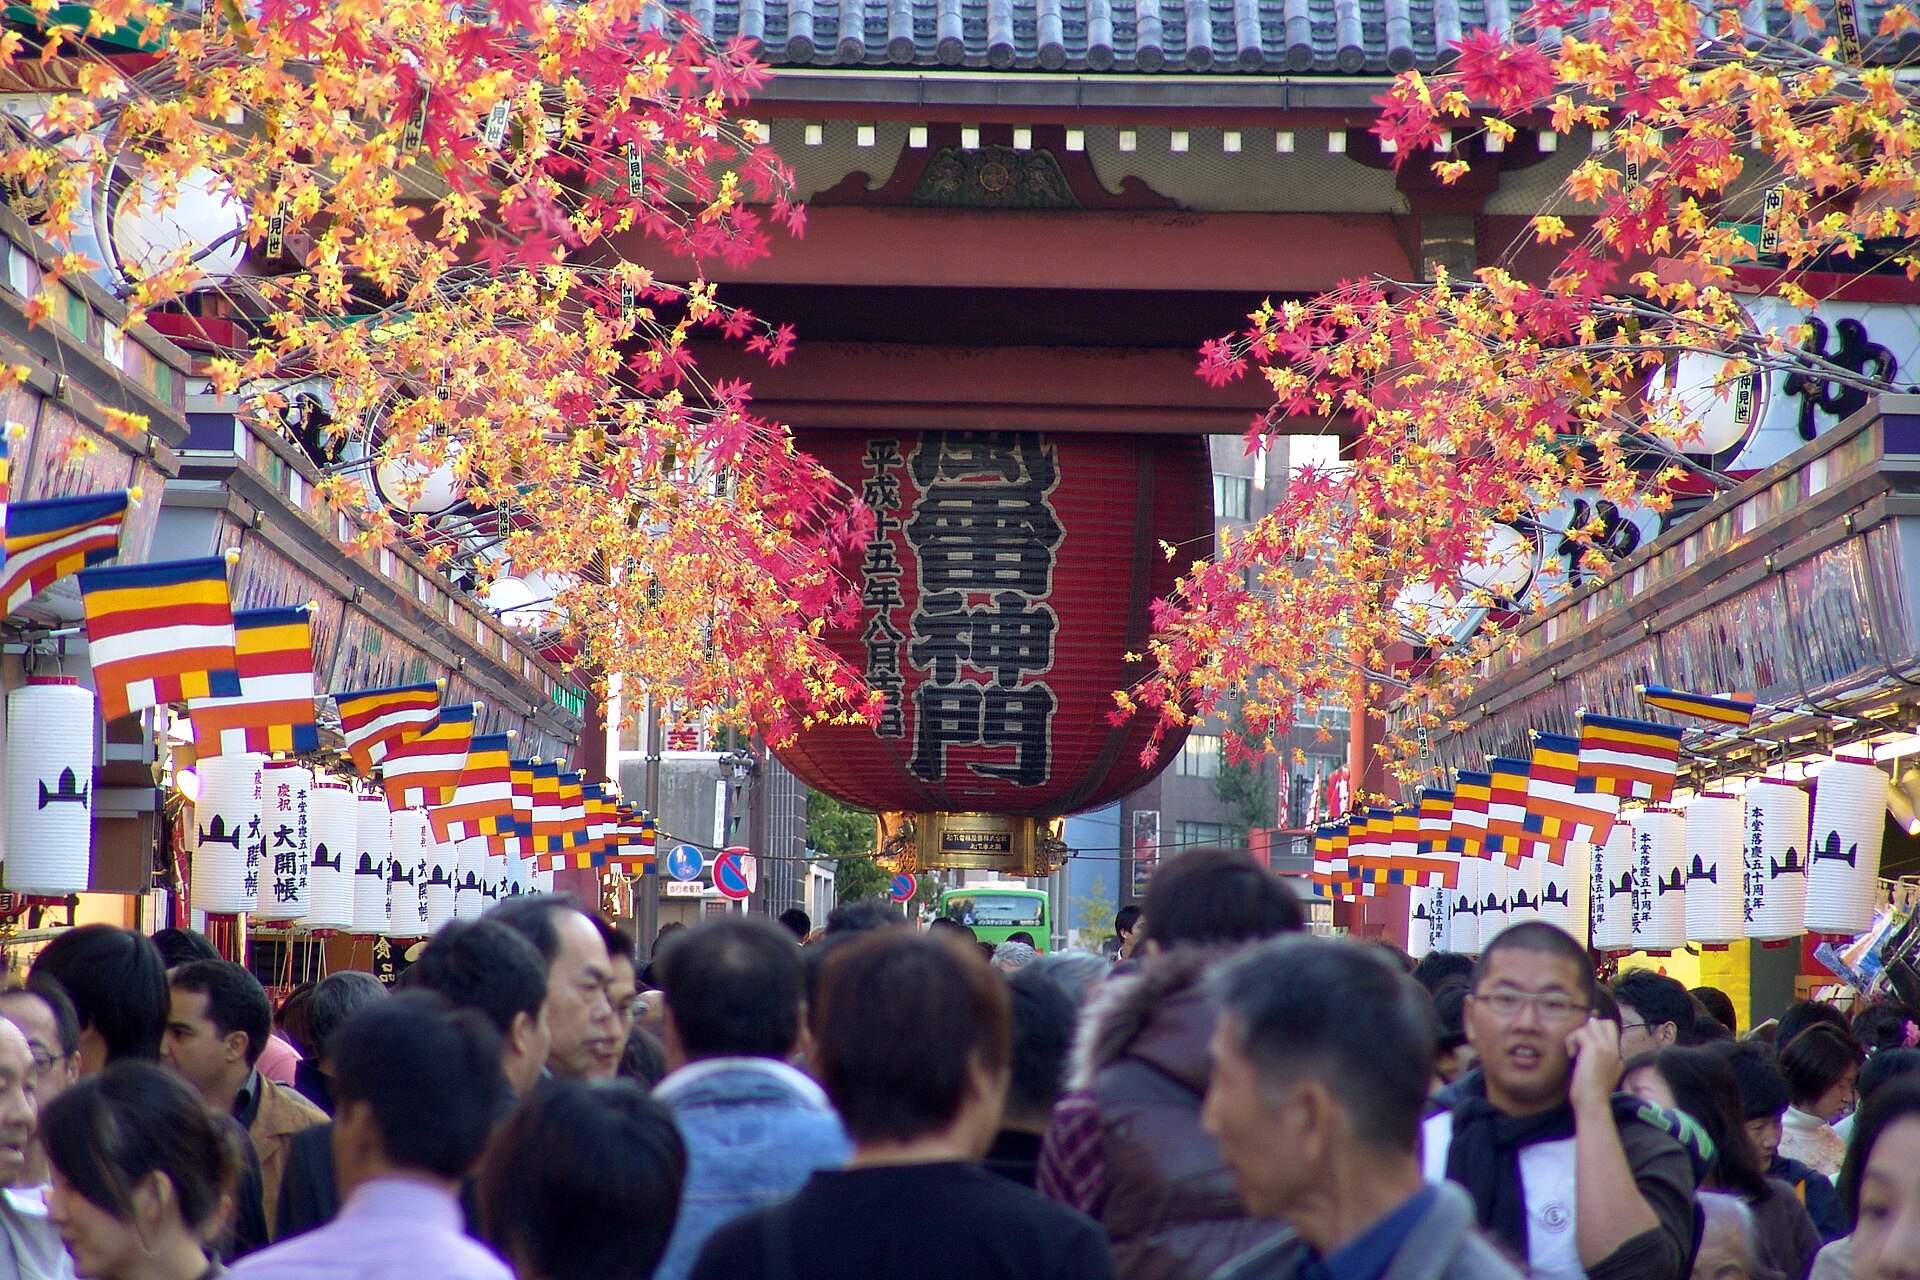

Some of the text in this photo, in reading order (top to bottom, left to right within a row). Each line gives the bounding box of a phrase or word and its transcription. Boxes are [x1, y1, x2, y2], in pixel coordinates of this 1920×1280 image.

[1764, 192, 1780, 249] 仲世
[437, 389, 450, 435] 仲世
[1738, 375, 1750, 420] 仲見世
[861, 438, 905, 738] 平成十五年八月吉日
[277, 783, 292, 812] 慶祝
[273, 824, 299, 903] 大開帳
[296, 788, 309, 889] 本堂落慶五十周年
[1751, 806, 1765, 909] 本堂落慶五十周年
[1640, 832, 1652, 922] 本堂落慶五十周年
[1435, 887, 1444, 939] 落慶五十周年
